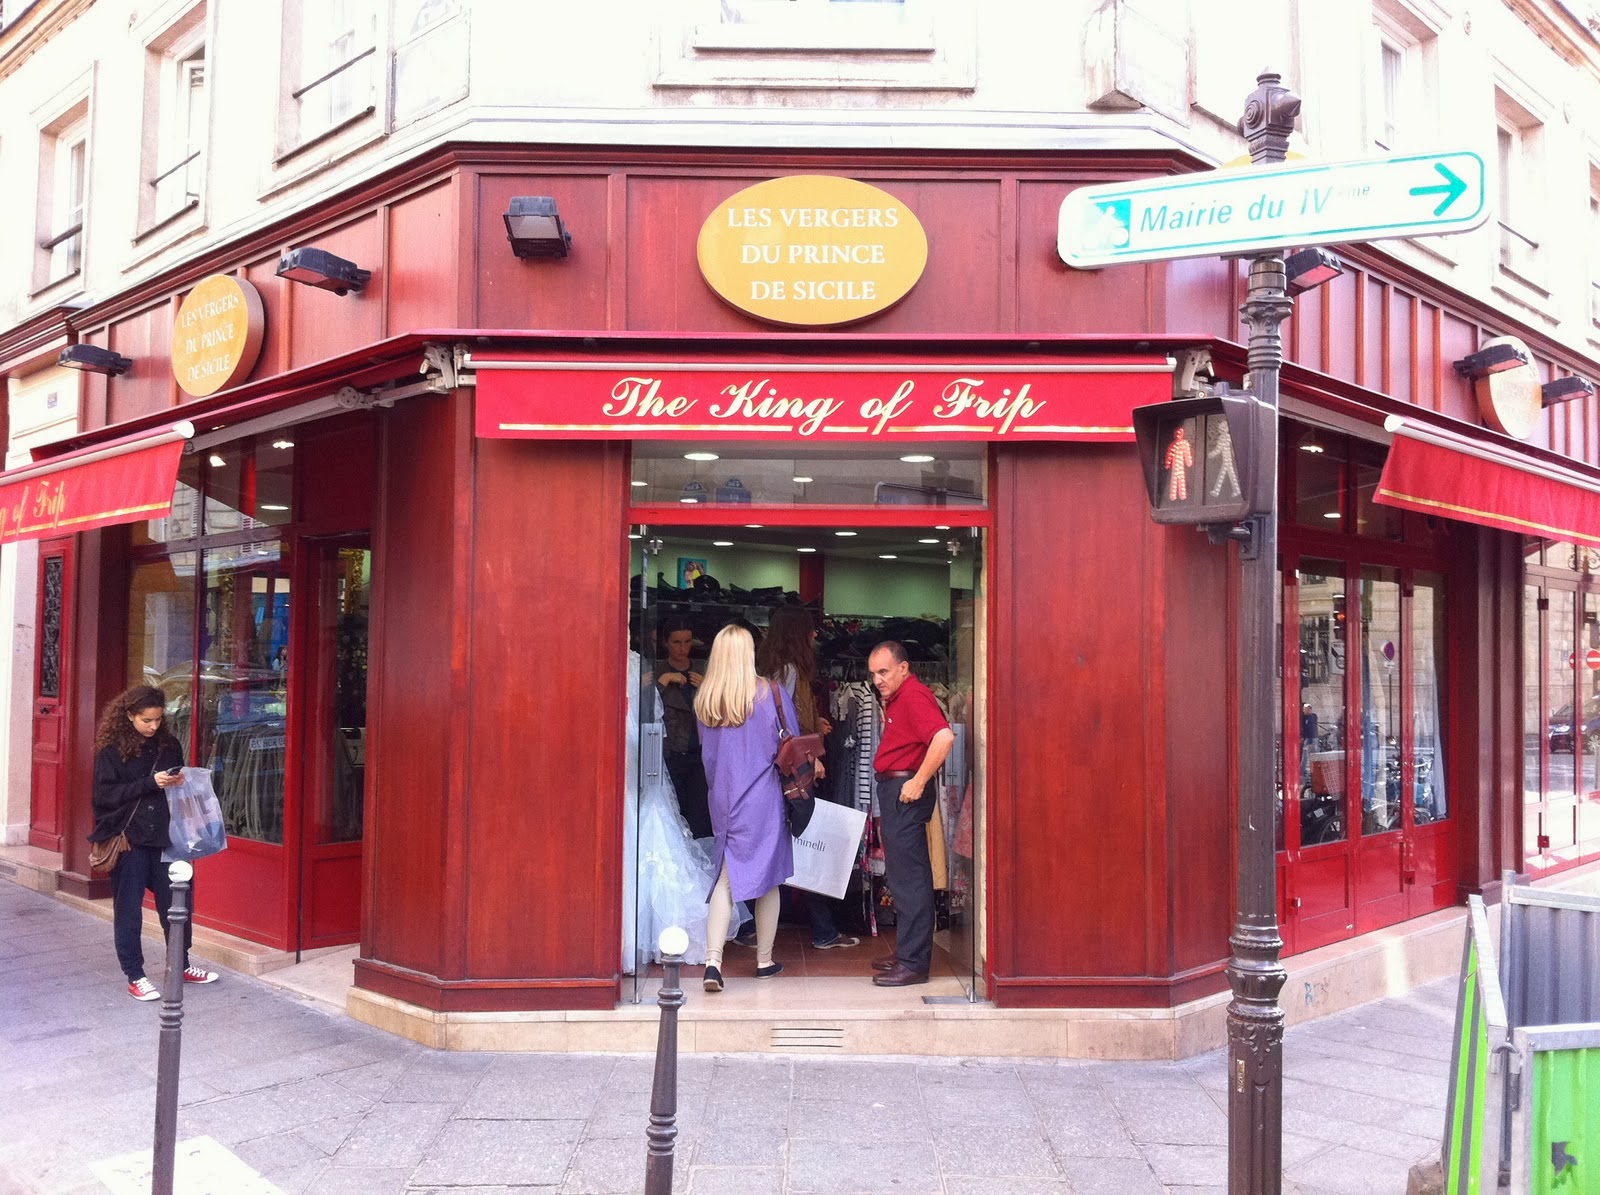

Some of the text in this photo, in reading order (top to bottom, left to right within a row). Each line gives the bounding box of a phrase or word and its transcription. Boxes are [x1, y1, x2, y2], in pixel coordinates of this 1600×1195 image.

[727, 207, 898, 228] LES VERGERS
[1140, 200, 1233, 233] Mairie
[1247, 193, 1285, 222] du
[740, 244, 886, 265] DU PRINCE
[751, 280, 876, 301] DE SICILE
[181, 293, 239, 329] LES VERGERS
[185, 322, 234, 355] DU PRINCE
[187, 354, 230, 382] DE SICILE
[602, 376, 1047, 437] The King of Frip
[12, 485, 29, 537] of
[33, 480, 66, 530] Frip
[793, 836, 826, 852] minelli
